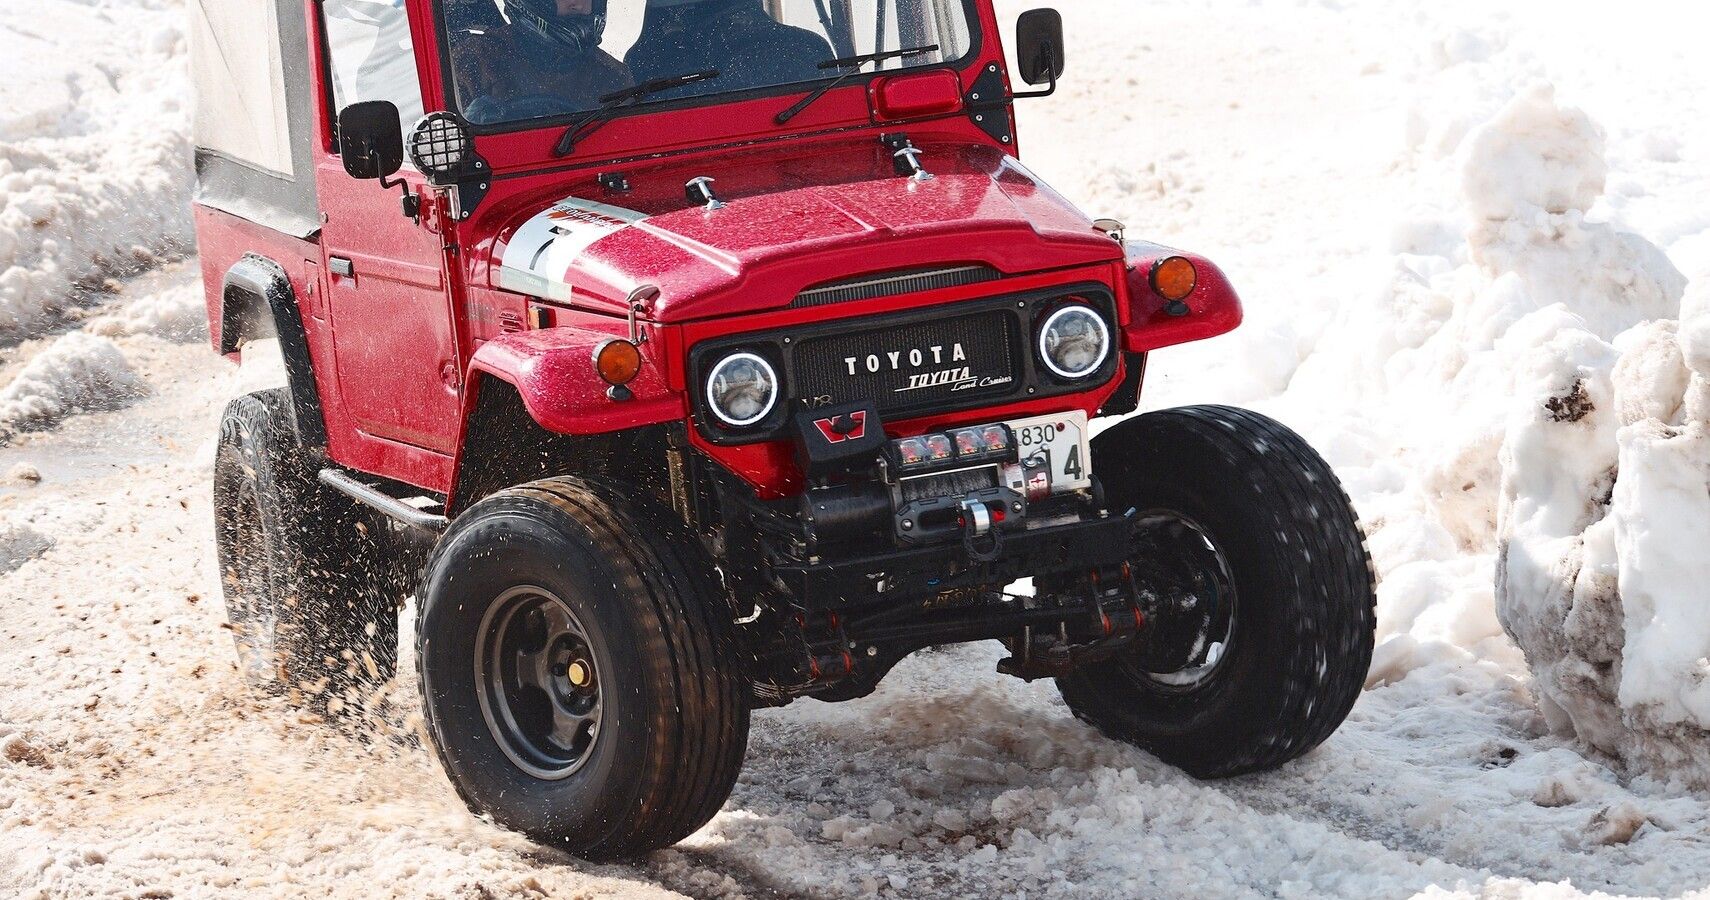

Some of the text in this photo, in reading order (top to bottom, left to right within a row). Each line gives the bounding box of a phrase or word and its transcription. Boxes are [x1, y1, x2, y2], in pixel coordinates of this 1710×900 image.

[844, 343, 967, 376] TOYOTA
[909, 366, 970, 388] TOYOTA
[950, 378, 979, 392] Land
